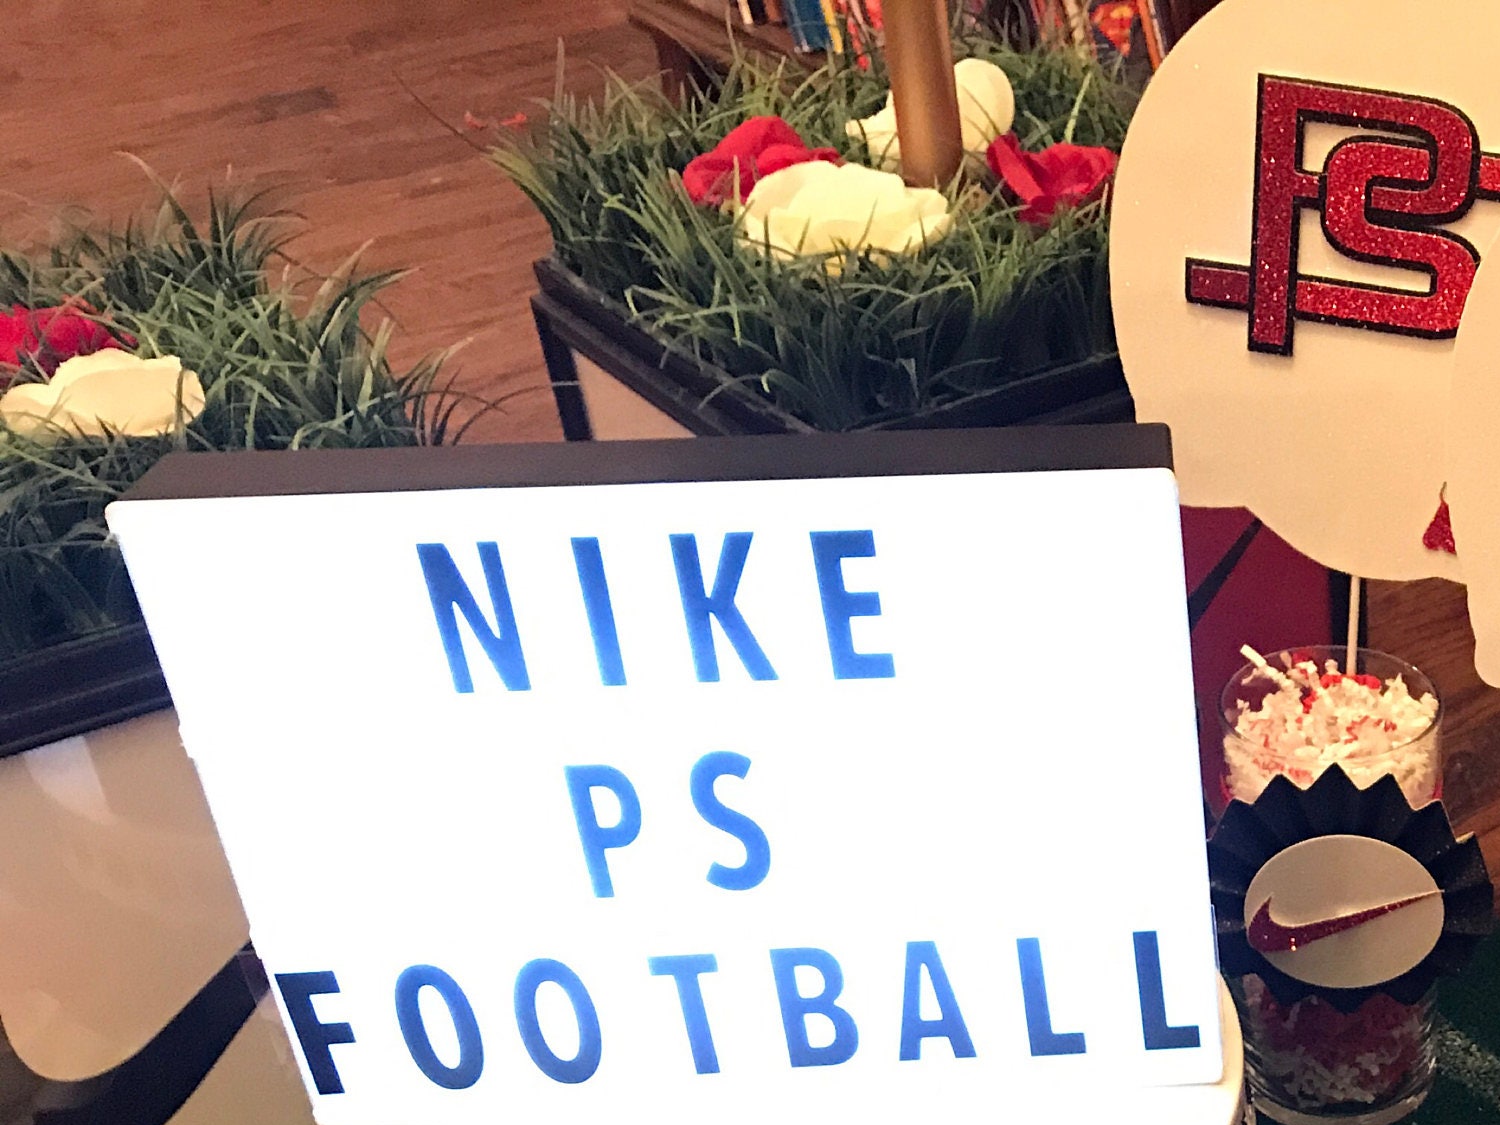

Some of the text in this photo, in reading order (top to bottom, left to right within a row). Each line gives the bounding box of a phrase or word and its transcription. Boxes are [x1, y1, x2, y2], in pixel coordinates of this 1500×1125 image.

[416, 530, 895, 693] NIKE
[564, 751, 770, 898] PS
[275, 931, 1200, 1094] FOOTBALL
